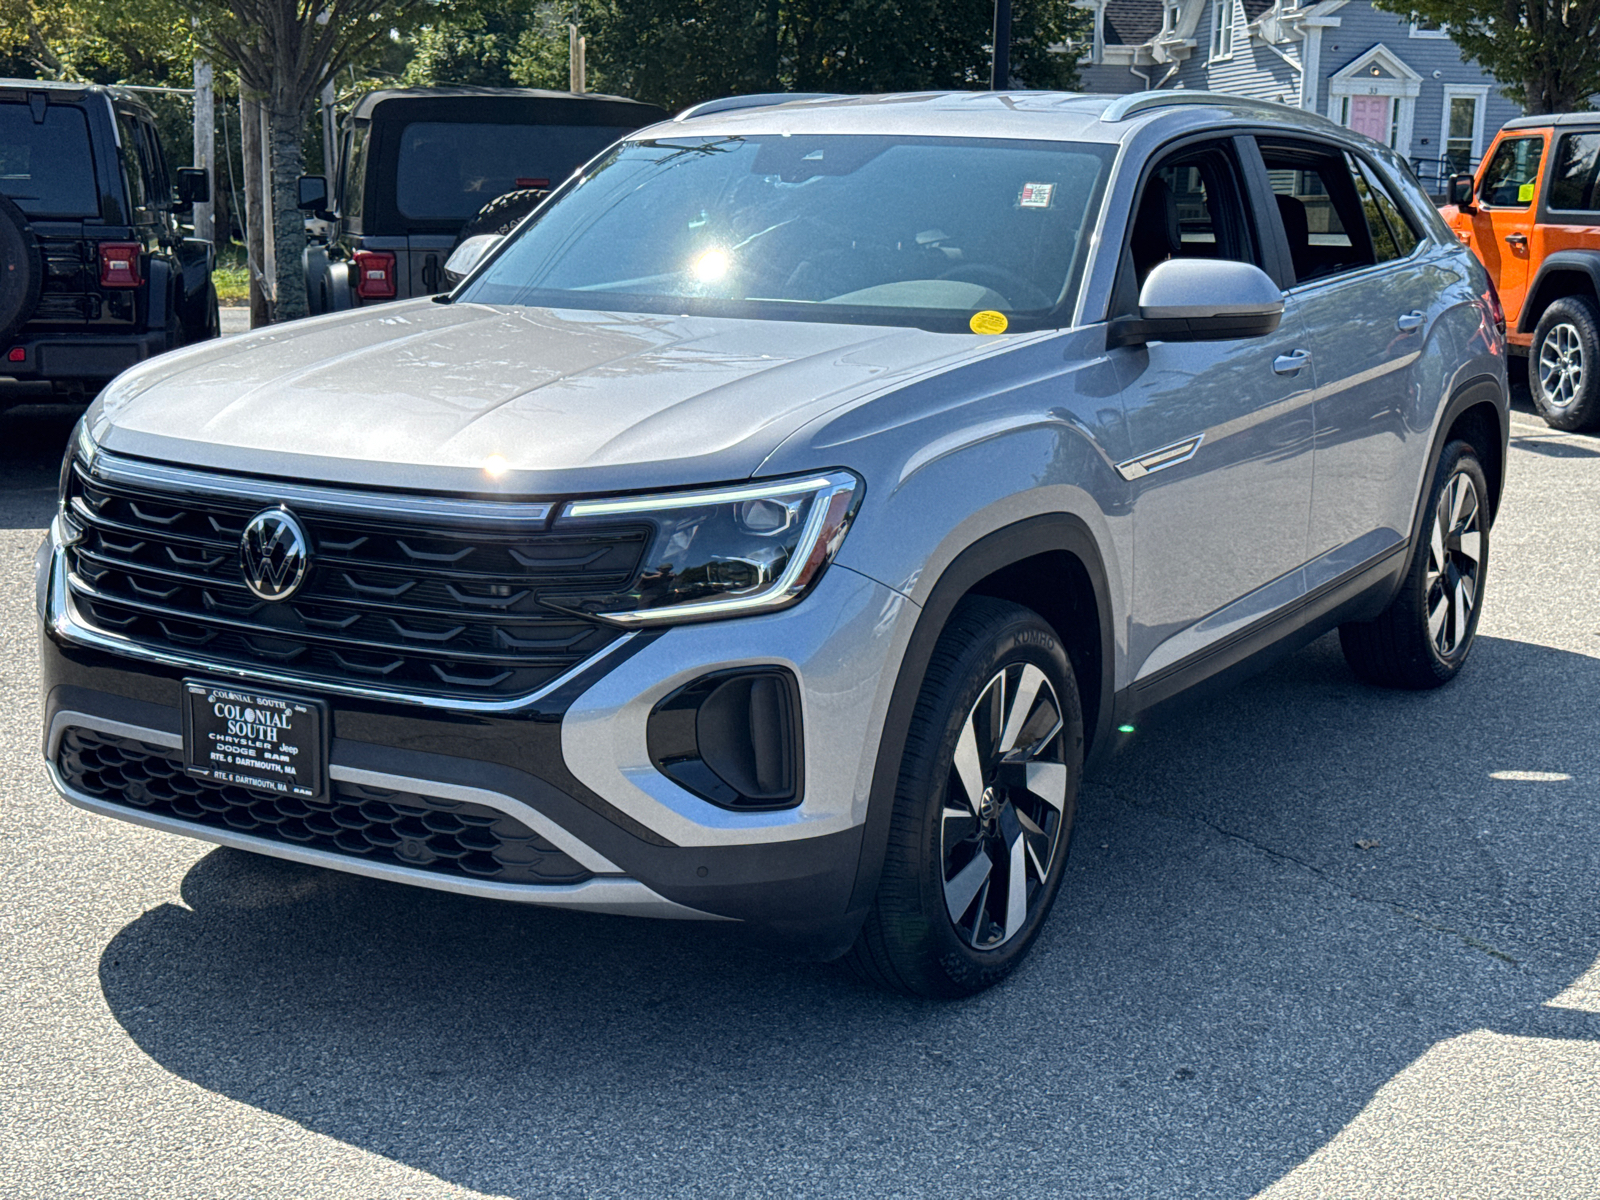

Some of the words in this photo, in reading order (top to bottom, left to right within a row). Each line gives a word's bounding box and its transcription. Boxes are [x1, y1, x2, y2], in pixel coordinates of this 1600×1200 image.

[1013, 629, 1055, 650] KUMHO
[212, 690, 253, 703] COLONIAL
[256, 697, 287, 709] SOUTH
[214, 702, 292, 730] COLONIAL
[227, 720, 278, 742] SOUTH
[208, 733, 272, 750] CHRYSLER
[279, 743, 299, 756] Jeep
[216, 743, 257, 757] DODGE
[264, 752, 290, 763] RAM
[210, 752, 226, 762] RTE.
[227, 754, 232, 763] 6
[235, 757, 283, 773] DARTMOUTH,
[284, 766, 297, 775] MA
[213, 770, 228, 780] RTE.
[229, 774, 233, 782] 6
[235, 775, 276, 791] DARTMOUTH,
[277, 783, 288, 792] MA
[293, 787, 313, 796] RAM
